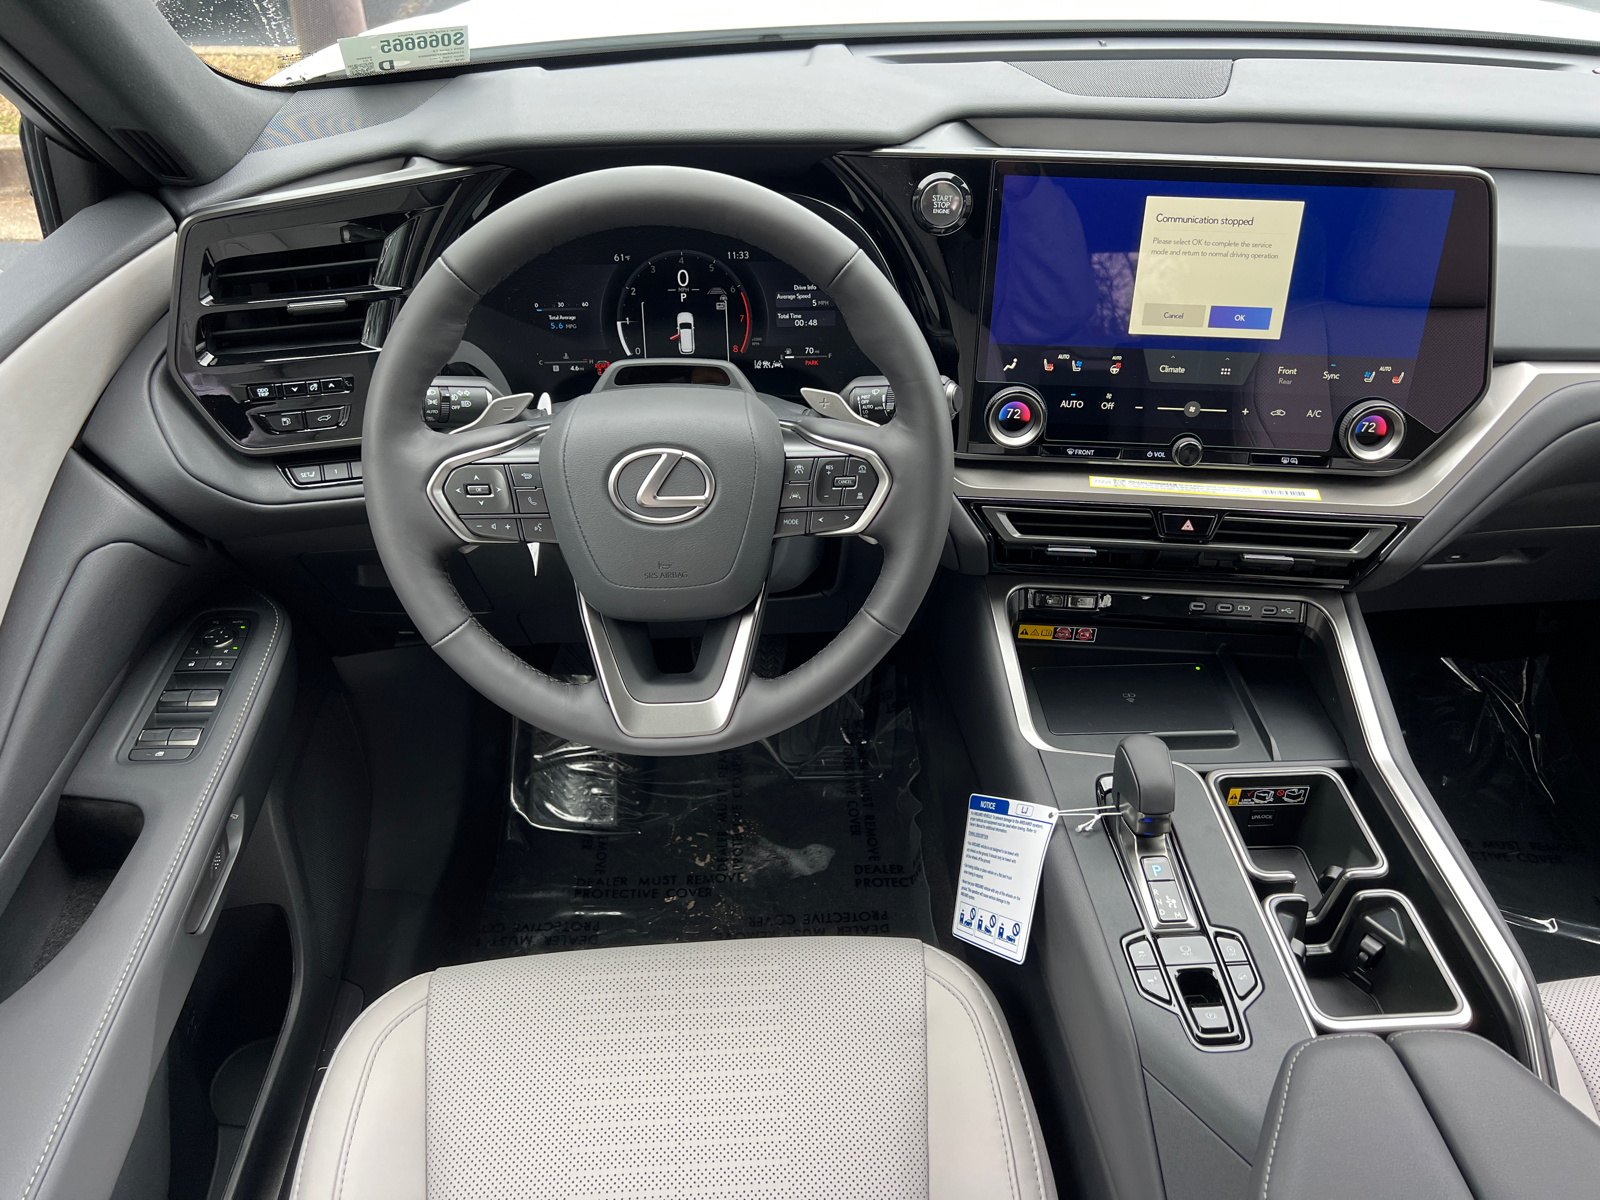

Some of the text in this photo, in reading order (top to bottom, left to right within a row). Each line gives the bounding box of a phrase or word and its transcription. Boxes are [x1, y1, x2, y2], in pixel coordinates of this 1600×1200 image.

[1156, 213, 1255, 227] Communication stopped
[1152, 237, 1172, 245] Please
[1173, 238, 1190, 246] select
[1192, 238, 1203, 246] OK
[1212, 240, 1239, 248] complete
[1240, 240, 1250, 248] the
[727, 251, 749, 260] 11:33
[1229, 251, 1249, 260] driving
[650, 265, 656, 273] 3
[709, 264, 714, 272] 5
[677, 269, 689, 287] 0
[630, 287, 636, 295] 2
[681, 293, 687, 302] P
[1163, 312, 1184, 320] Cancel
[1234, 314, 1246, 322] OK
[794, 319, 818, 327] 00:48
[1159, 365, 1186, 374] Climate
[1277, 366, 1297, 375] Front
[1322, 371, 1340, 381] Sync
[1060, 400, 1084, 409] AUTO
[1101, 401, 1115, 410] Off
[1006, 408, 1021, 419] 72
[1306, 409, 1322, 418] A/C
[1361, 422, 1376, 433] 72
[659, 571, 689, 579] AIRBAG
[980, 800, 996, 810] NOTICE
[854, 864, 904, 876] DEALER
[1151, 864, 1162, 877] P
[577, 872, 743, 887] DEALER MUST REMOVE
[574, 887, 713, 899] PROTECTIVE COVER
[1153, 888, 1159, 896] R
[803, 911, 888, 925] PROTECTIVE
